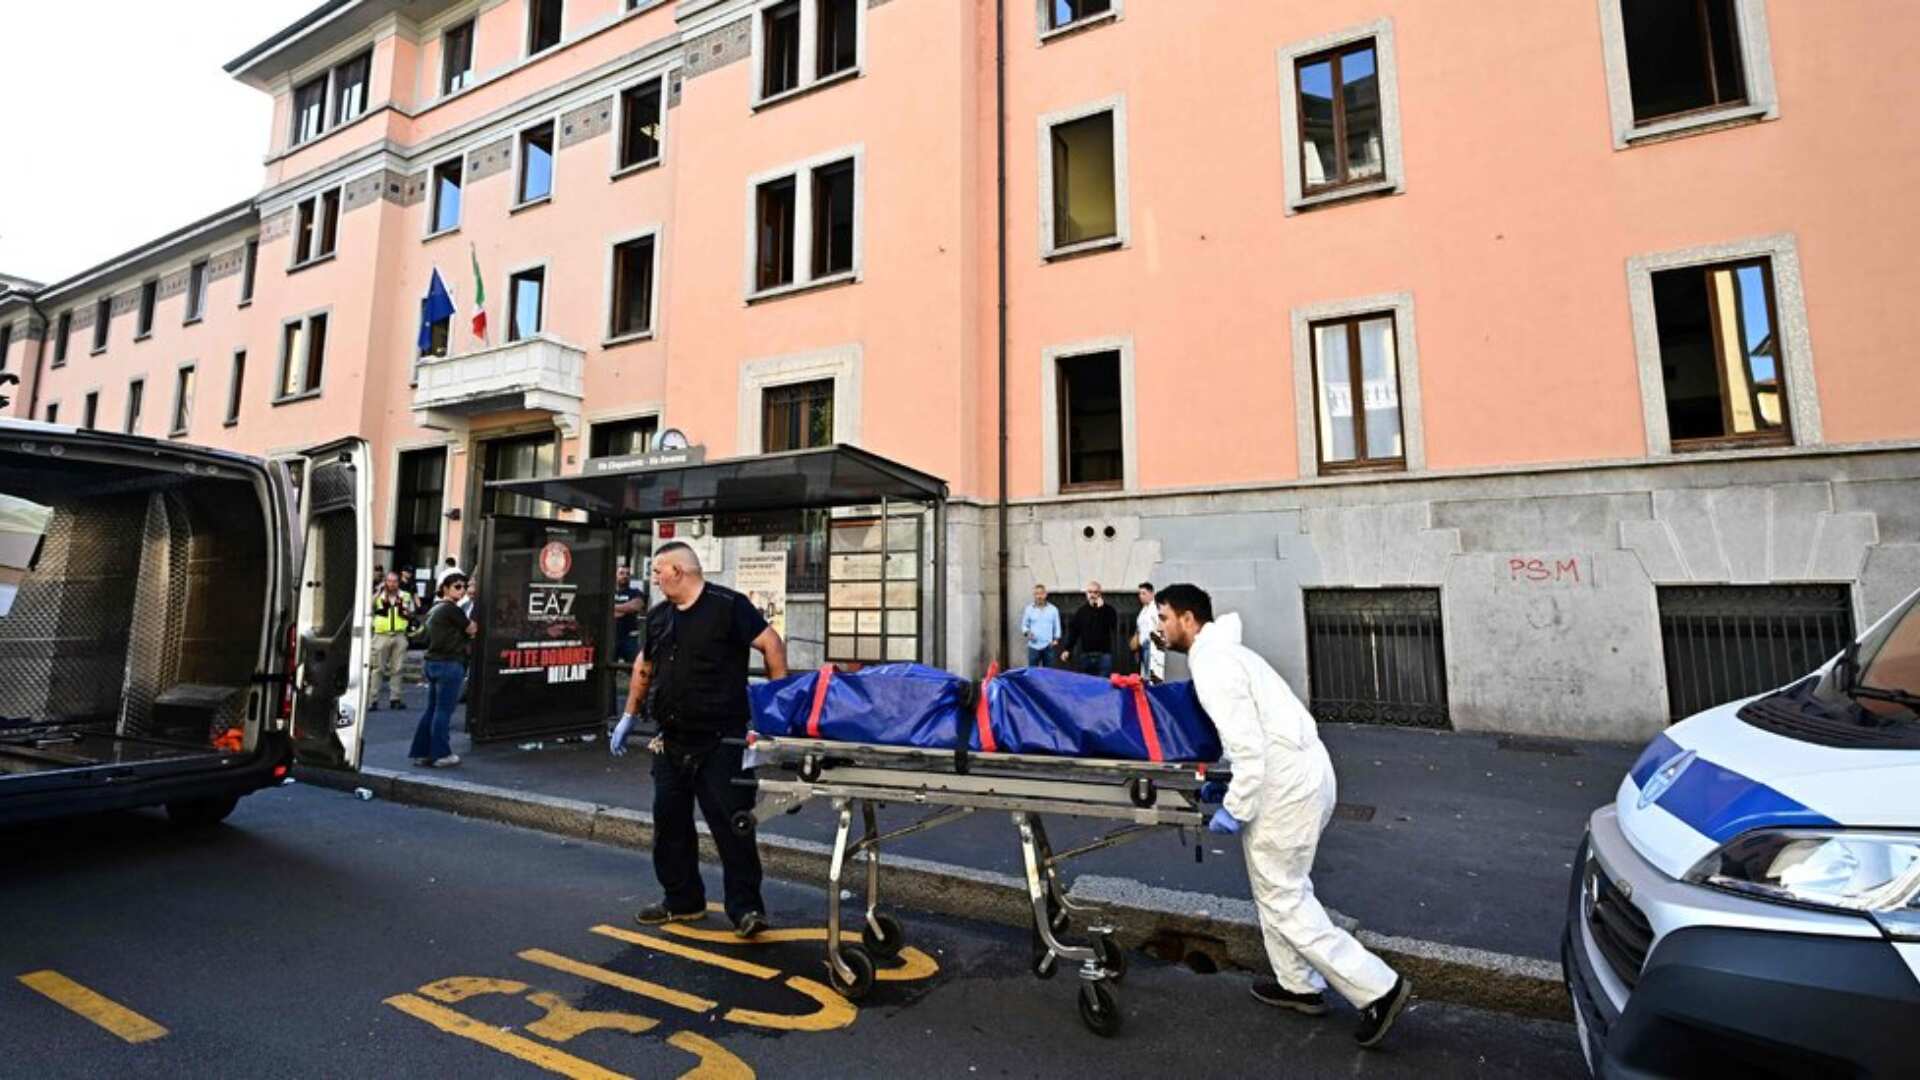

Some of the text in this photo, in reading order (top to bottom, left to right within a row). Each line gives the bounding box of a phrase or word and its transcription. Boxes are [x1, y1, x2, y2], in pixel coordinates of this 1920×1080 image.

[1509, 558, 1580, 583] PSM
[528, 592, 577, 615] EA7
[382, 902, 940, 1080] BUS
